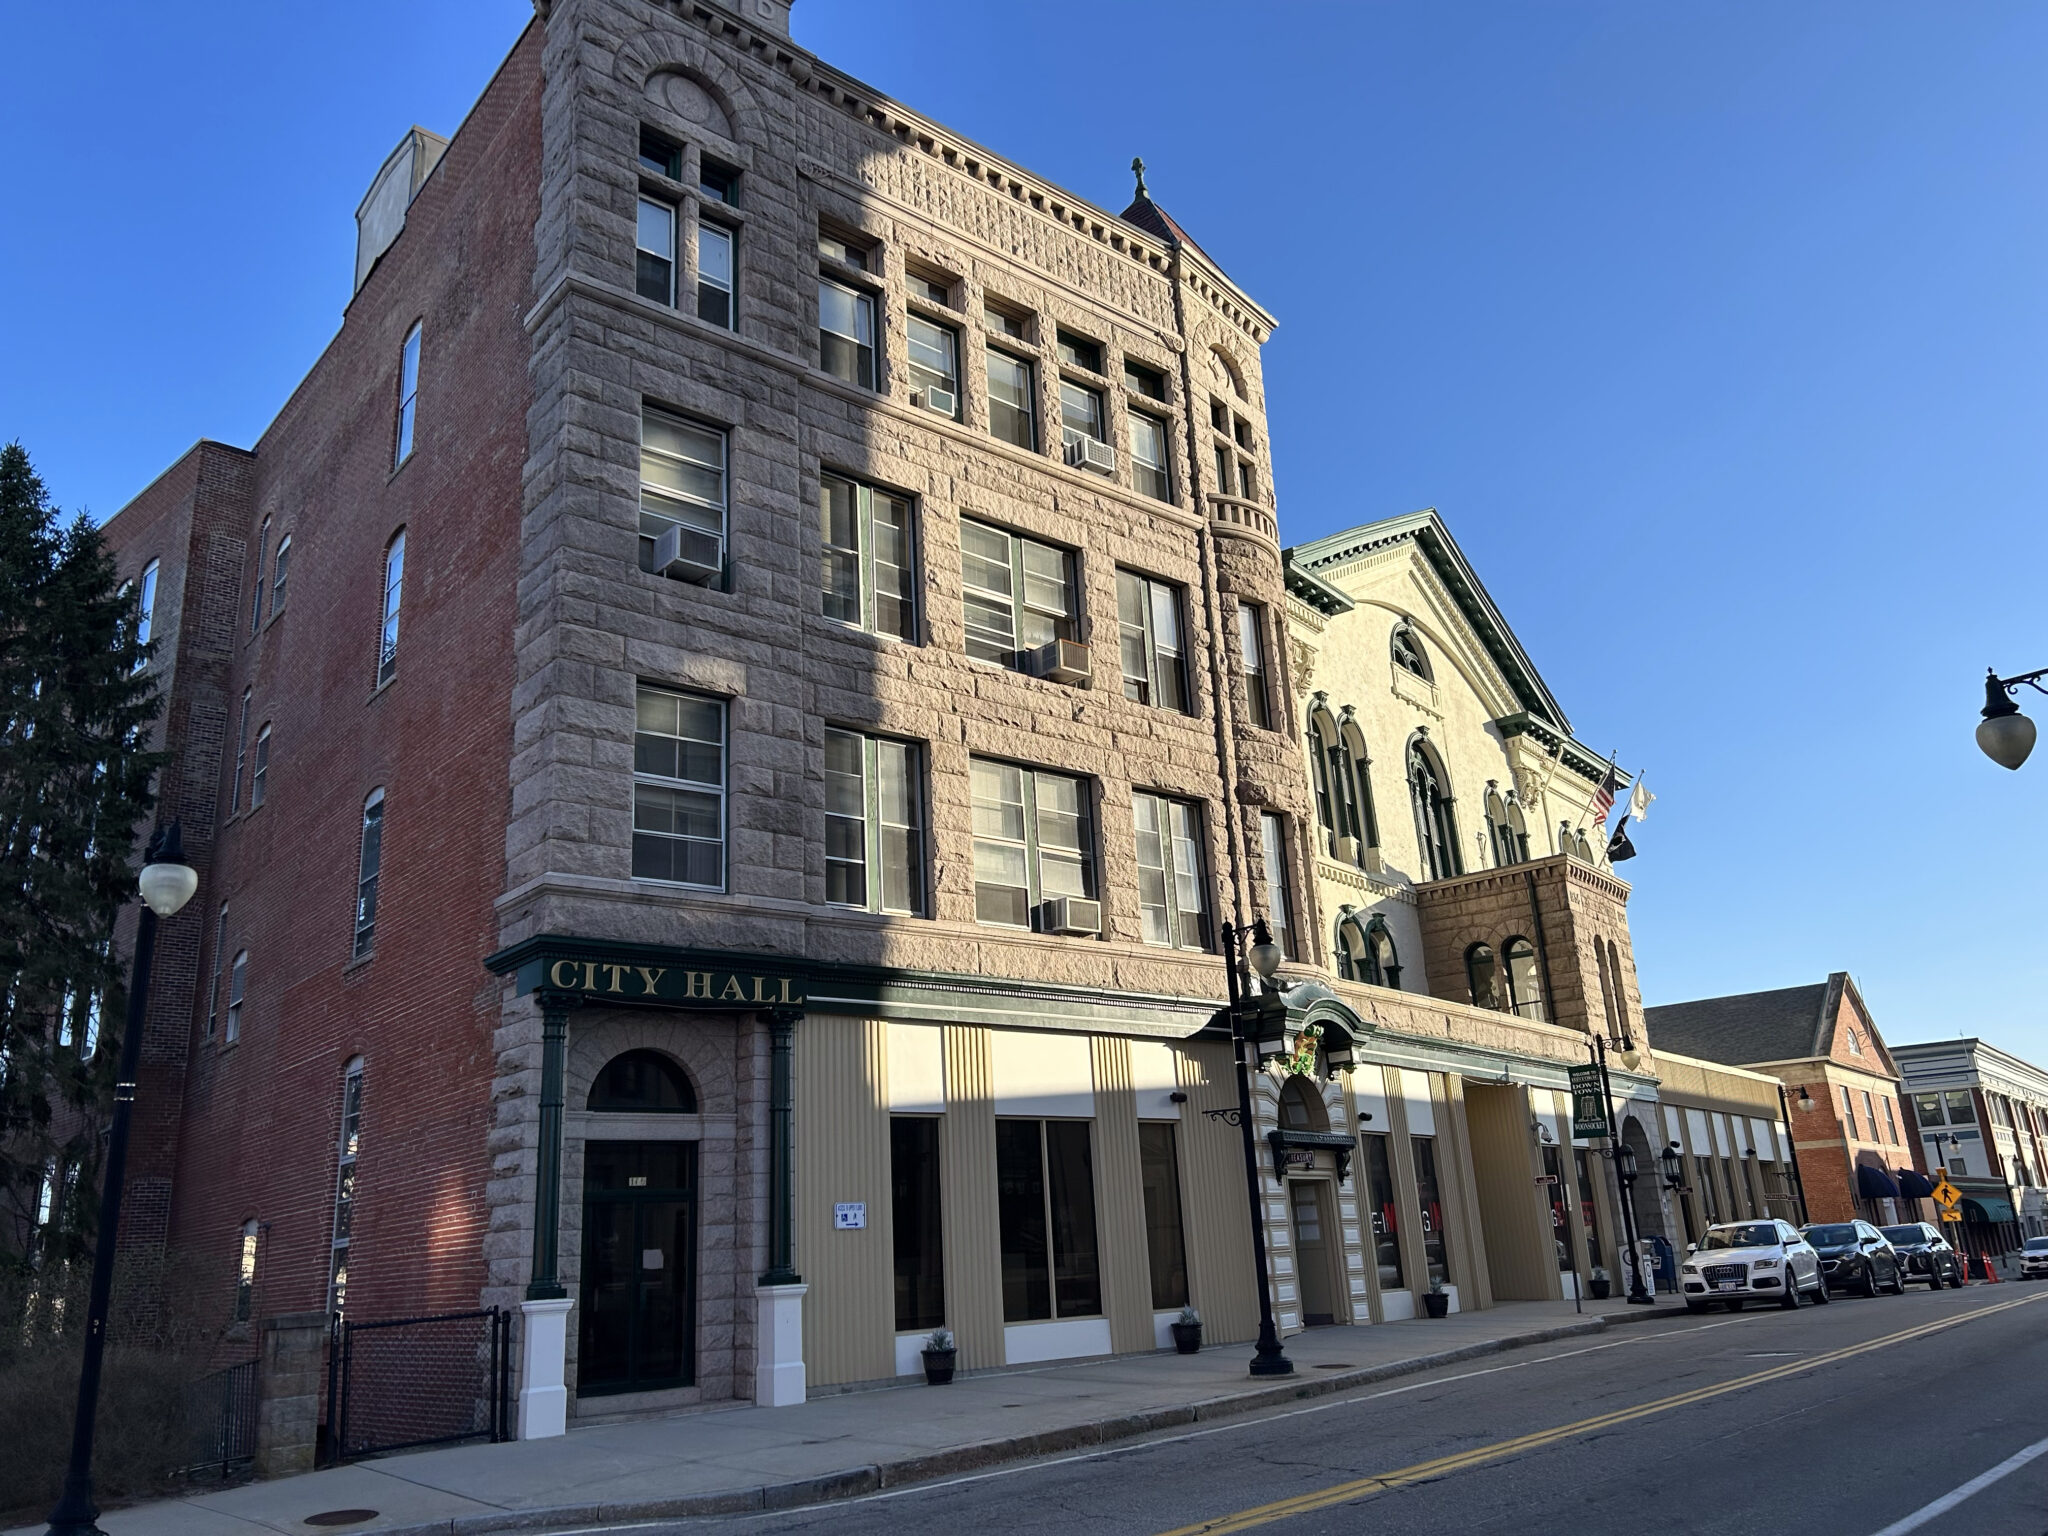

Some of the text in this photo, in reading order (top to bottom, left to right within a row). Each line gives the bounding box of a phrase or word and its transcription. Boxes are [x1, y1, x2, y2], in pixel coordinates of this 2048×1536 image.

[550, 959, 803, 1004] CITY HALL
[1572, 1081, 1600, 1090] DOWN
[1574, 1087, 1601, 1095] TOWN
[1574, 1121, 1606, 1131] WOONSOCKET
